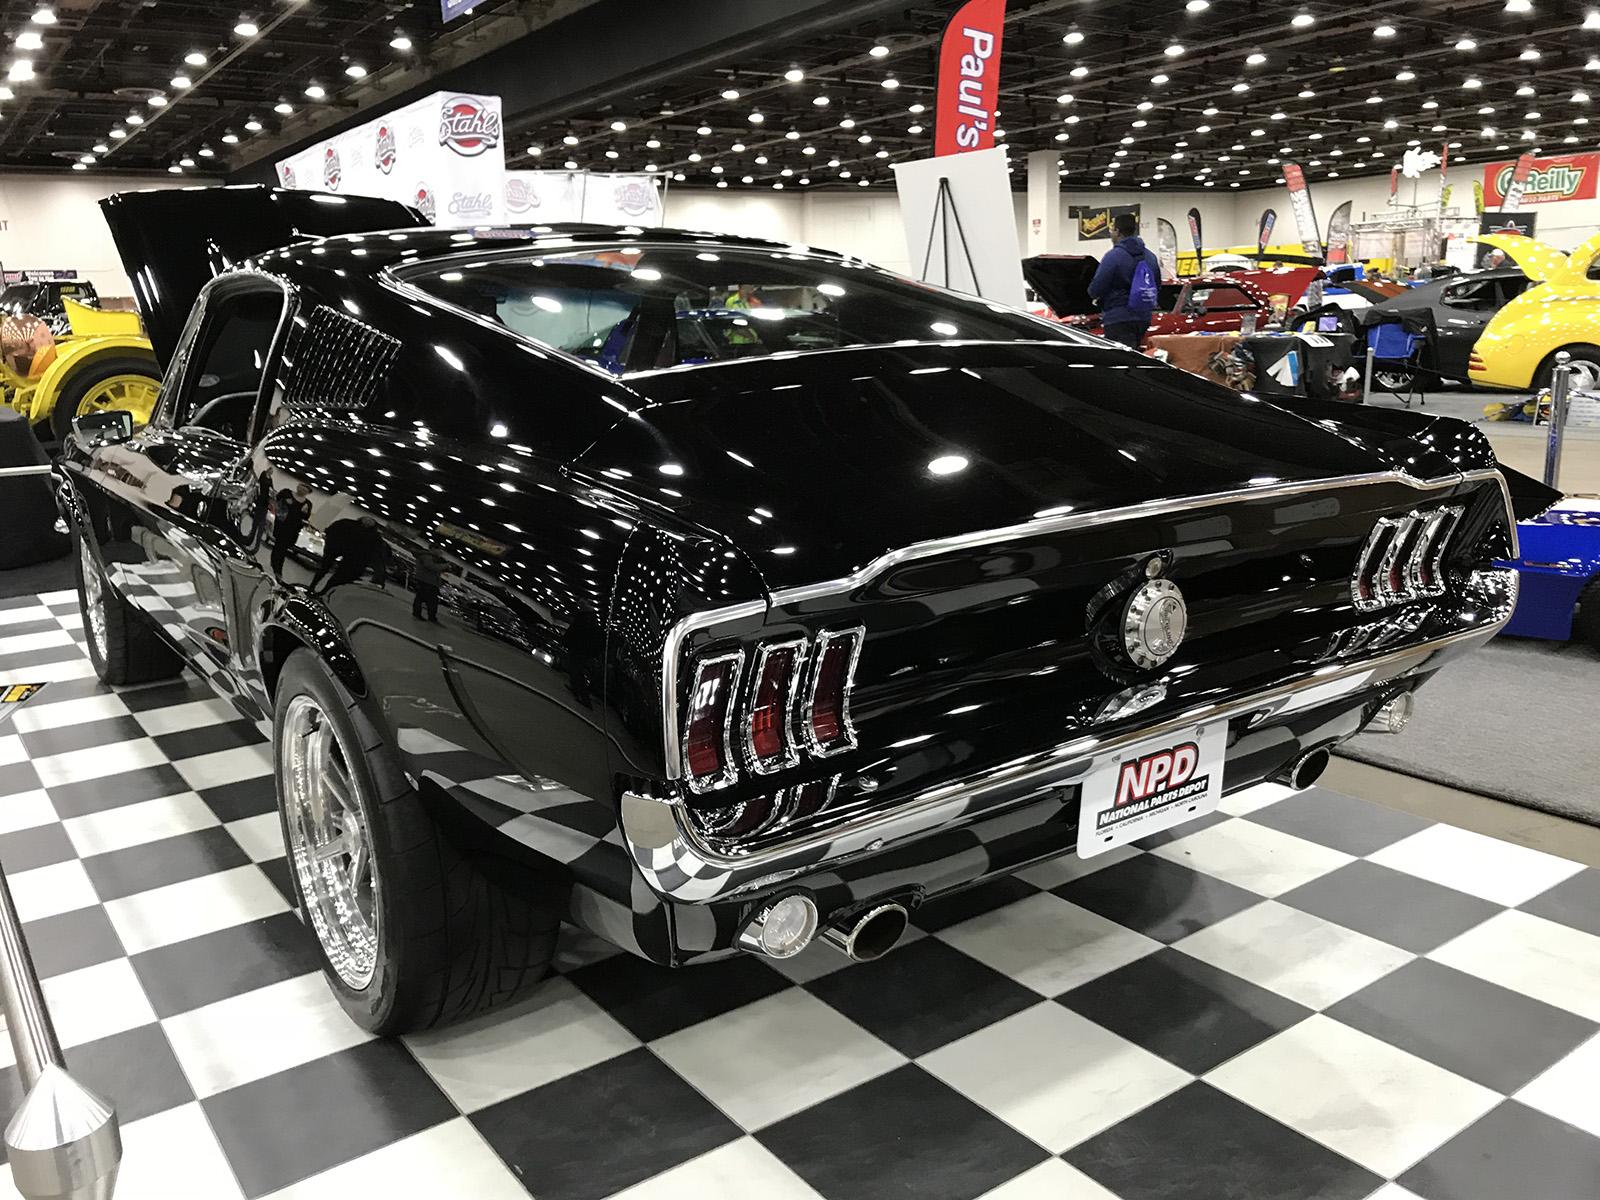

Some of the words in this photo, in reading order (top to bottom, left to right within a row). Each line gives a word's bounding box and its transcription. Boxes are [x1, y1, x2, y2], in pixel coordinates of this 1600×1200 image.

[957, 27, 994, 148] Paul's
[439, 107, 500, 146] Stahls
[1498, 167, 1580, 193] OReilly
[448, 192, 492, 216] Stahls
[1116, 746, 1198, 806] NPD
[1095, 826, 1114, 836] FLORIDA
[1119, 816, 1144, 828] CALIFORNIA
[1149, 806, 1170, 817] MICHIGAN
[1174, 800, 1188, 809] NORTH
[1188, 793, 1208, 803] CAROLINA
[1099, 800, 1149, 826] NATIONAL
[1150, 790, 1178, 807] PARTS
[1178, 779, 1207, 798] DEPOT
